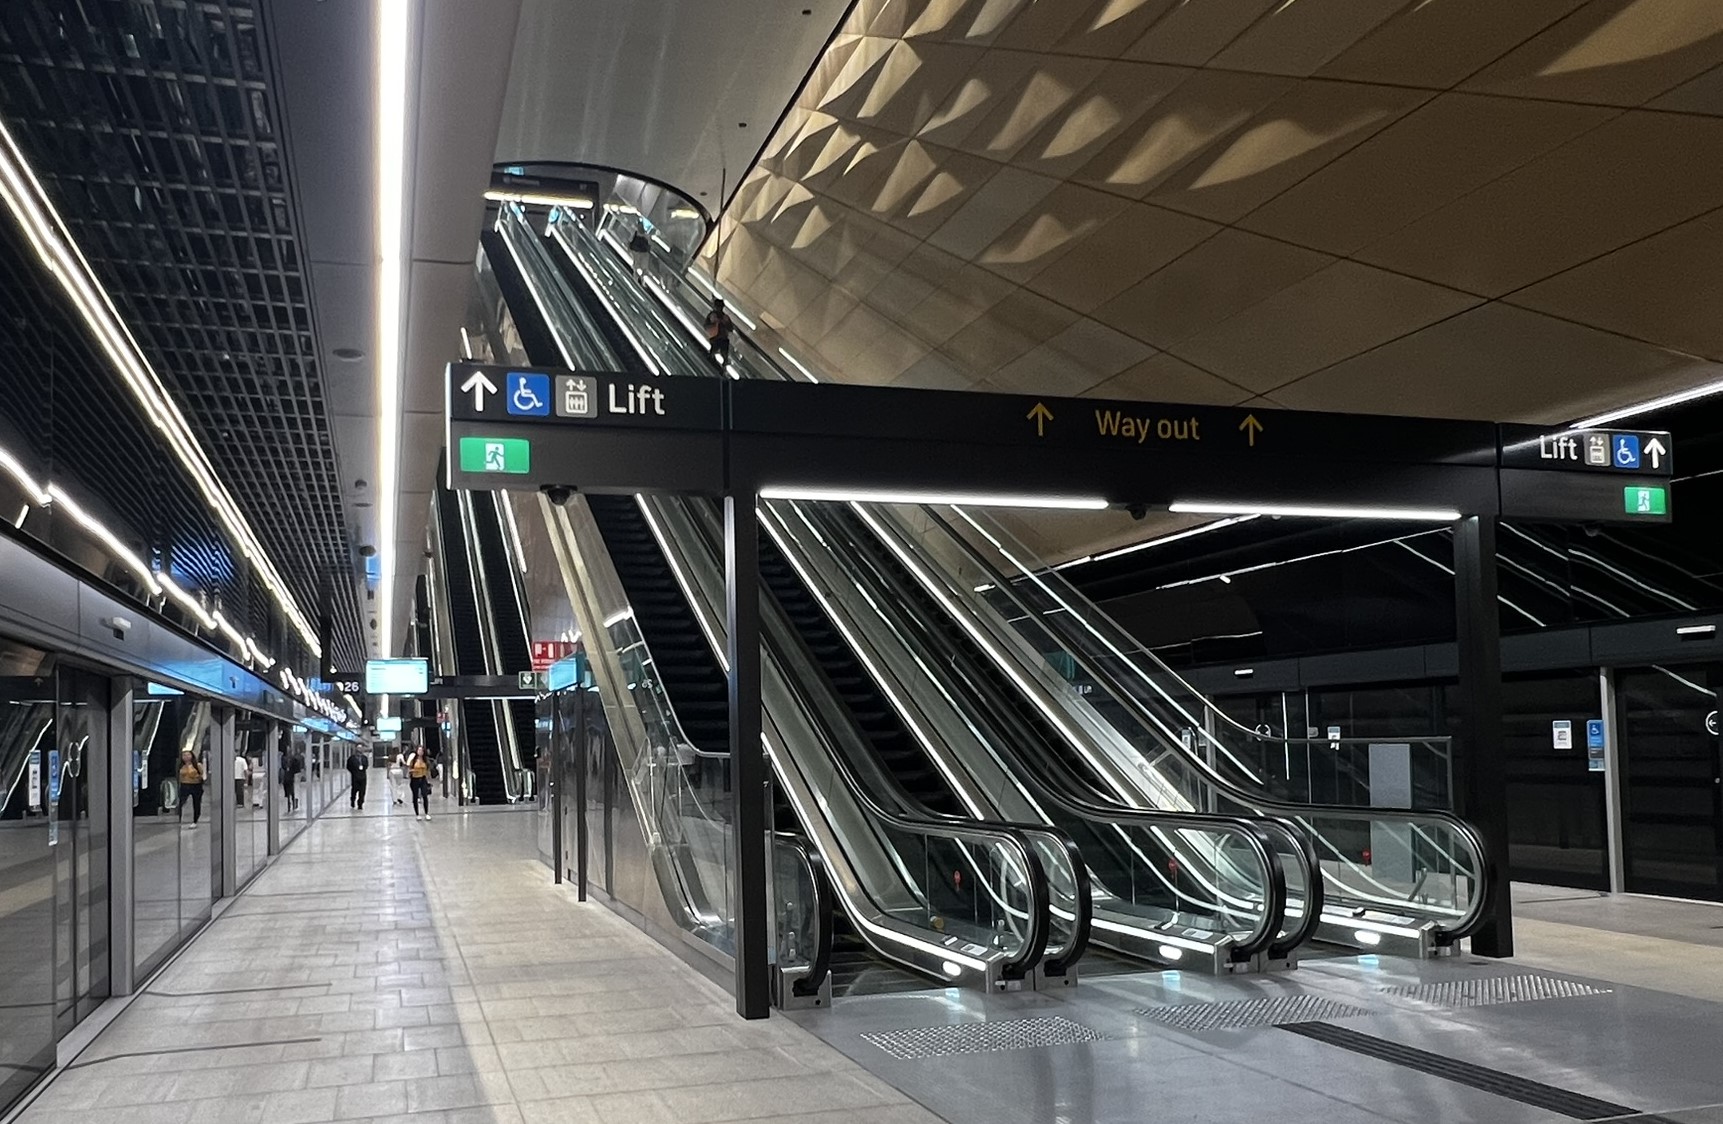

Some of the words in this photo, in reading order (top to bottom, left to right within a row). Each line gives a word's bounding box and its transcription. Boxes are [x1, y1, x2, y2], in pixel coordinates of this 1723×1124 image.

[608, 383, 666, 415] Lift
[1095, 409, 1150, 444] Way
[1157, 416, 1200, 440] out
[1540, 435, 1578, 460] Lift
[344, 681, 359, 692] 26
